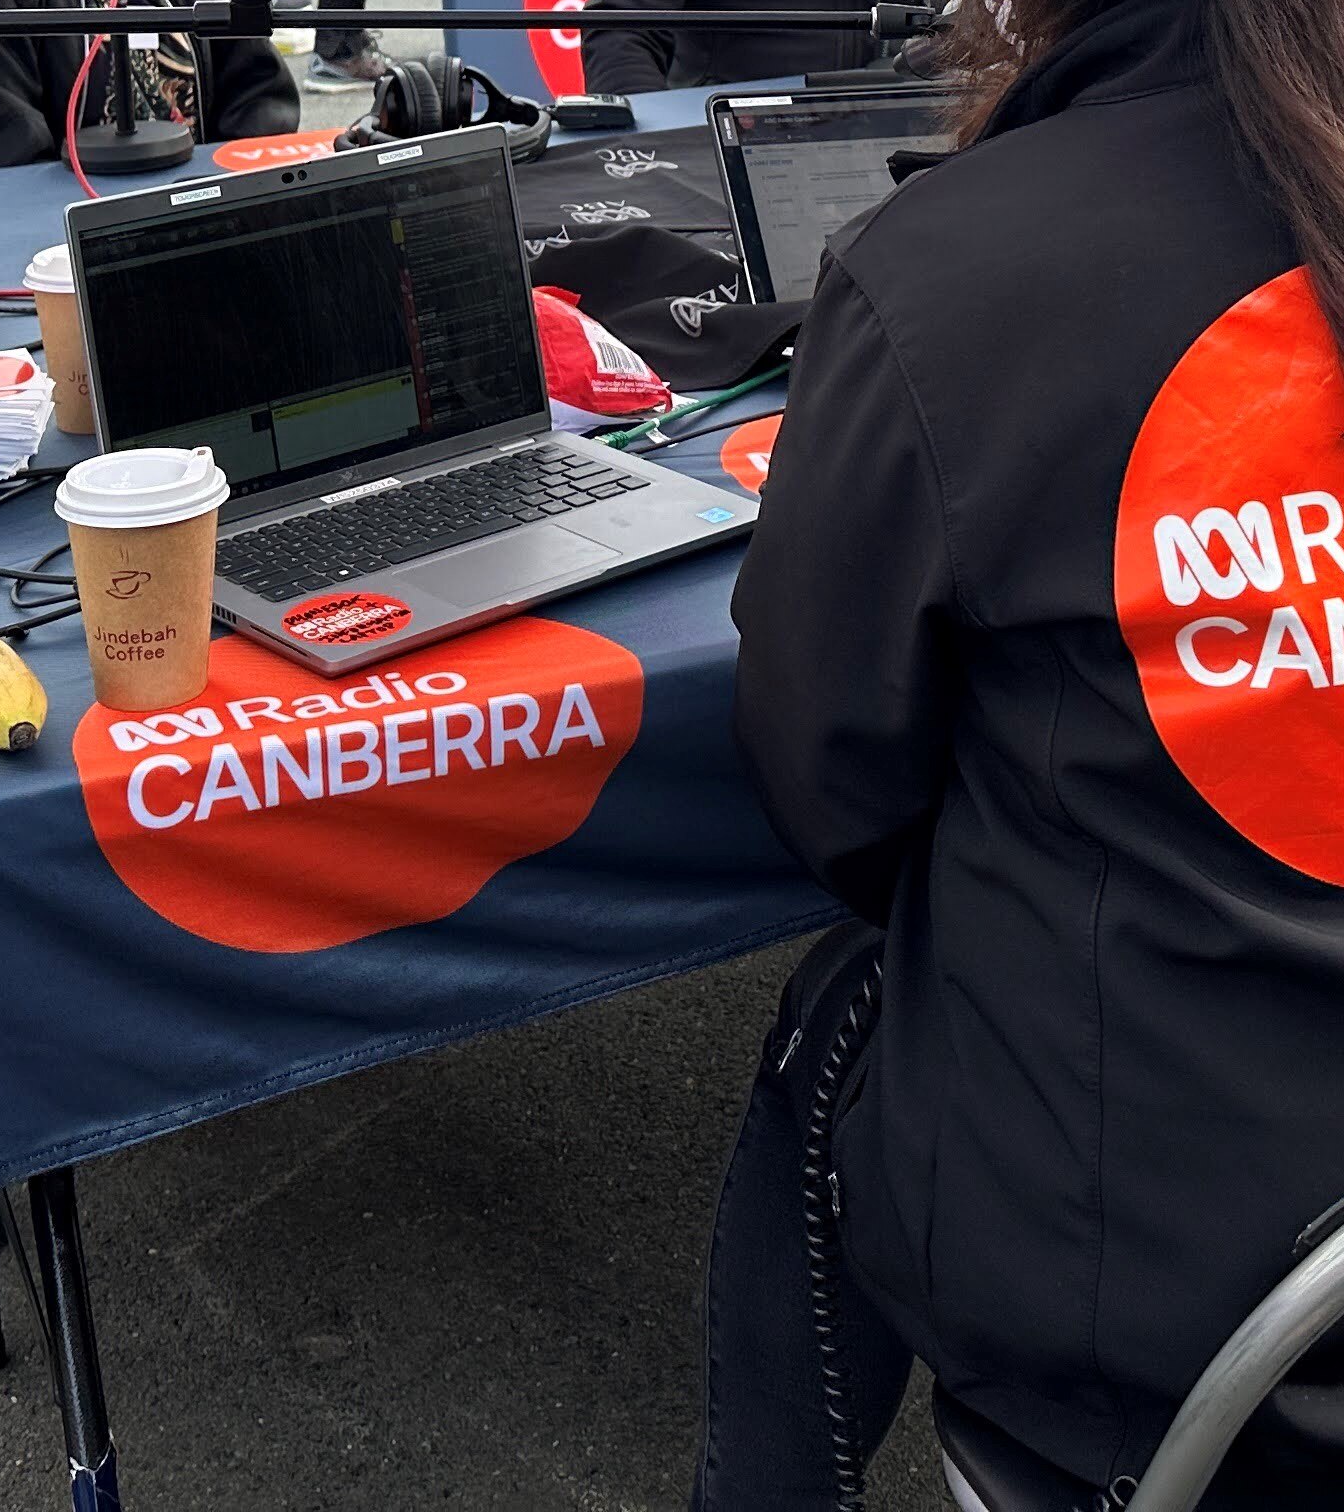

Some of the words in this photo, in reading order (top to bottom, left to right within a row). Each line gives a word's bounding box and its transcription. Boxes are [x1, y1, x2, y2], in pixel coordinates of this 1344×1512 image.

[594, 148, 657, 163] ABC
[303, 604, 402, 640] CANBERRA
[311, 607, 364, 630] Radio
[94, 624, 177, 646] Jindebah
[104, 644, 166, 662] Coffee
[222, 670, 469, 732] Radio
[126, 682, 607, 830] CANBERRA
